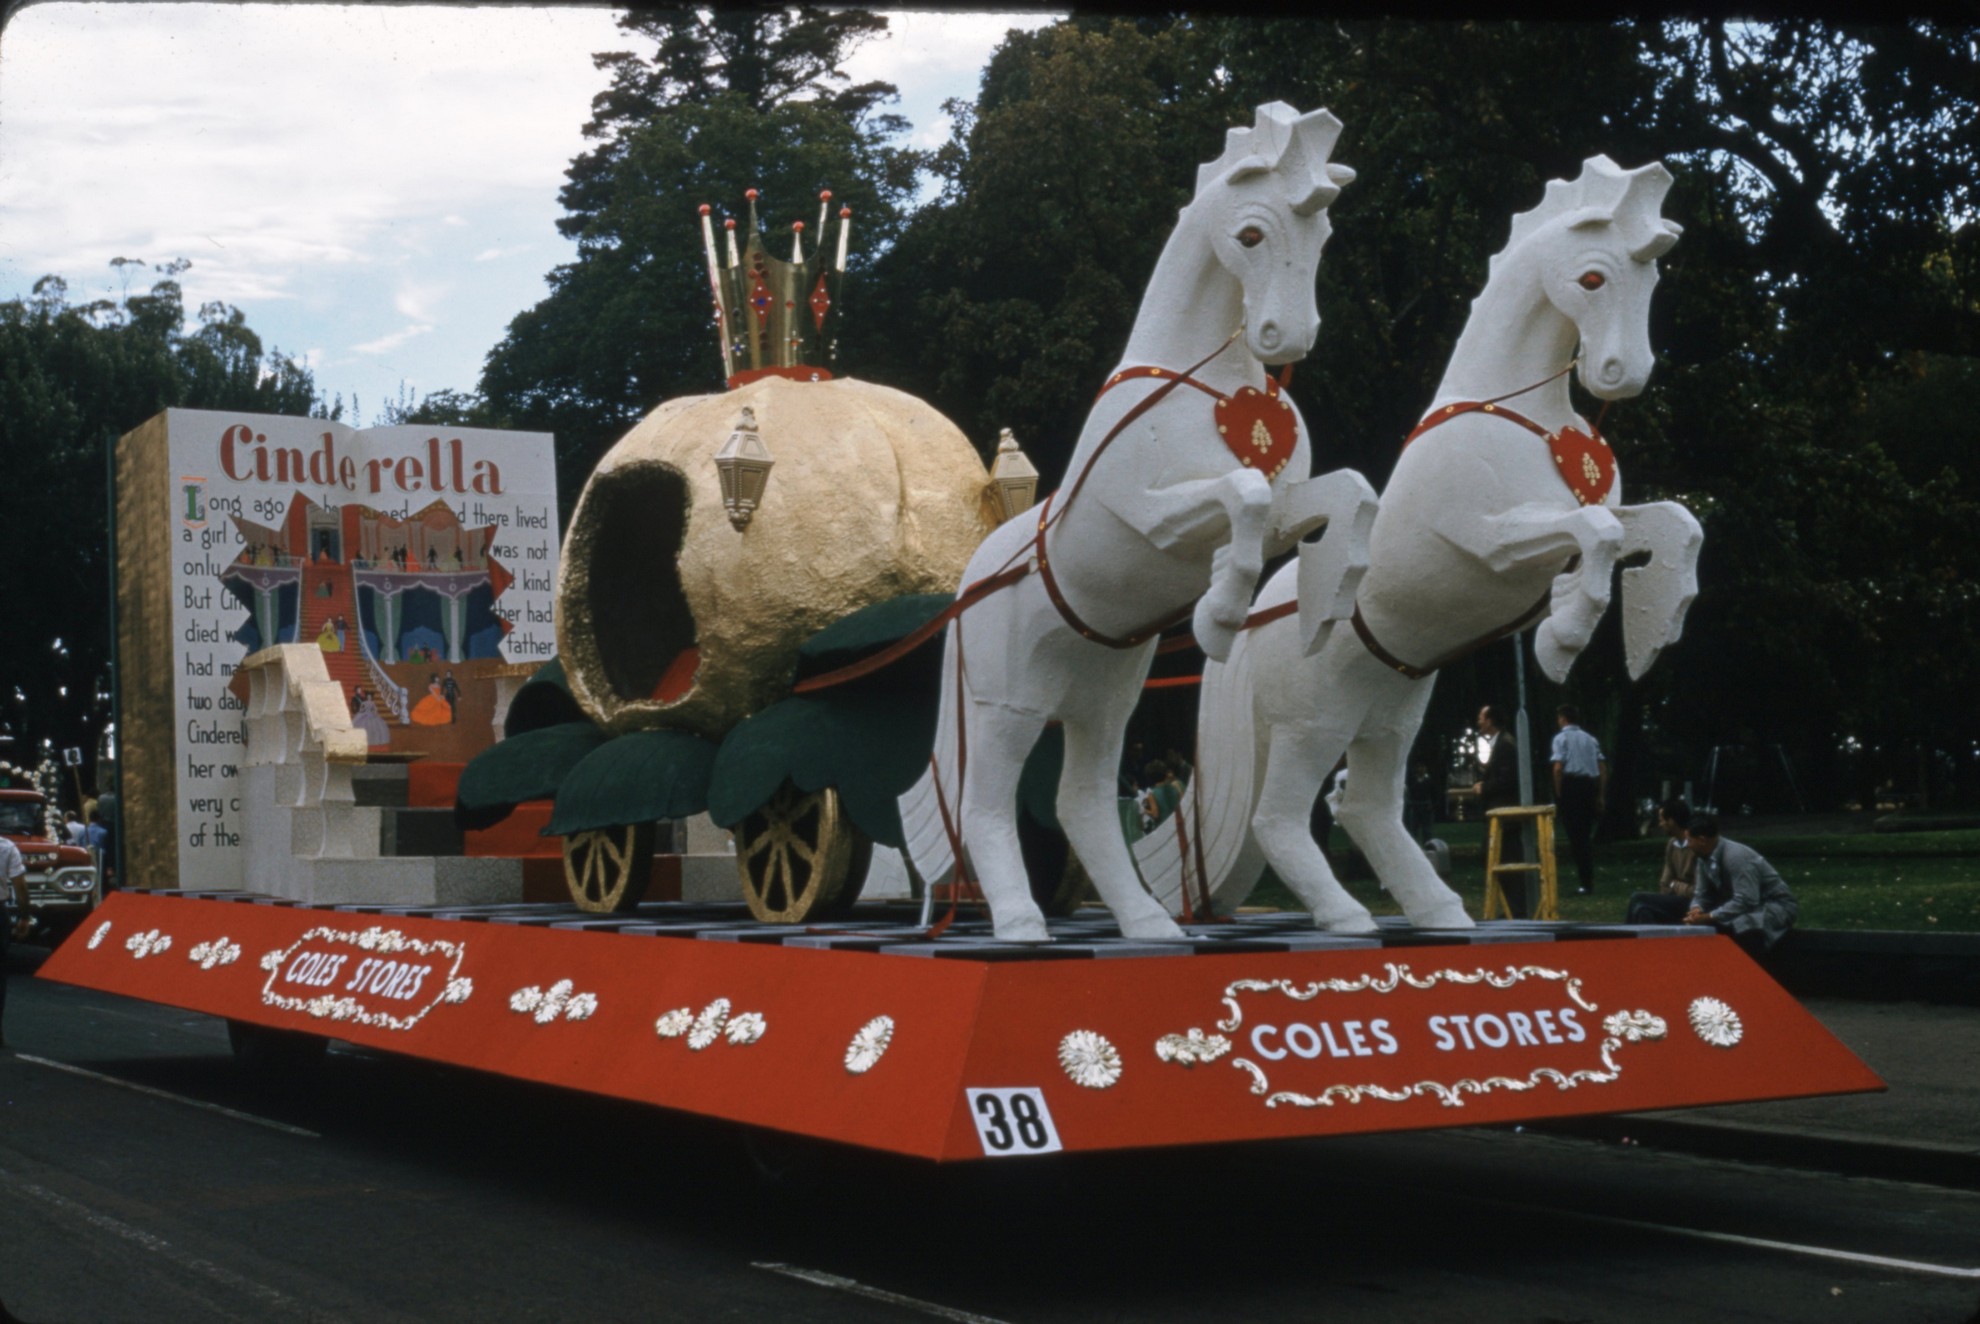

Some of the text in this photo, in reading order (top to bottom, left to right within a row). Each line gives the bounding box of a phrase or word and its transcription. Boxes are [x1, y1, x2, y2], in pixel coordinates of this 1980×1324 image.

[219, 424, 505, 495] Cinderella
[183, 485, 243, 519] Long
[253, 497, 285, 521] ago
[473, 502, 509, 526] there
[516, 505, 548, 529] lived
[183, 528, 193, 543] a
[201, 520, 226, 550] girl
[493, 544, 519, 558] was
[527, 540, 549, 560] not
[523, 568, 551, 591] kind
[184, 585, 552, 622] But Cin ther had
[185, 618, 219, 643] died
[507, 631, 554, 655] father
[186, 652, 213, 676] had
[187, 687, 213, 710] two
[187, 719, 249, 744] Cinderell
[188, 754, 238, 778] her ow
[189, 798, 223, 818] very
[189, 822, 207, 847] of
[285, 952, 431, 1000] COLES STORES
[1251, 1008, 1586, 1060] COLES STORES
[975, 1093, 1049, 1151] 38
